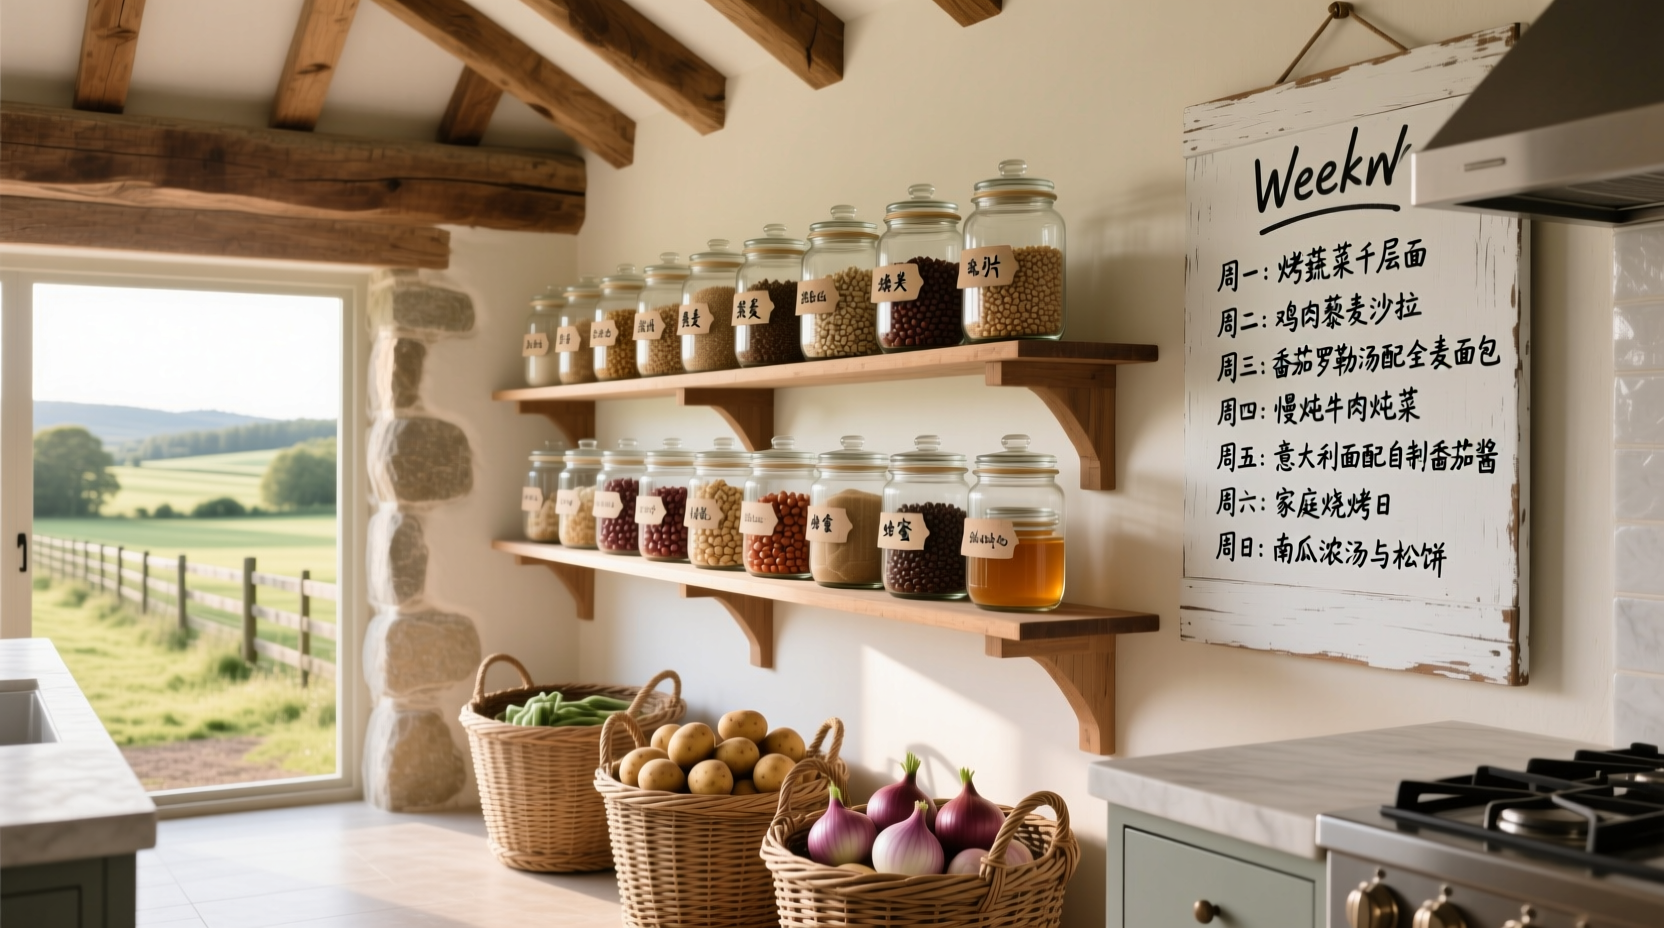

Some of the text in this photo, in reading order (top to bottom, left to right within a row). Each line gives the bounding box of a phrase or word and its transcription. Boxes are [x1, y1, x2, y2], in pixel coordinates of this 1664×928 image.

[1217, 335, 1500, 383] 周三：番茄罗勒汤配全麦面包
[1218, 386, 1420, 427] 周四：慢炖牛肉炖菜
[1217, 487, 1390, 520] 周六：家庭烧烤日
[1216, 532, 1446, 578] 周日：南瓜浓汤与松饼
